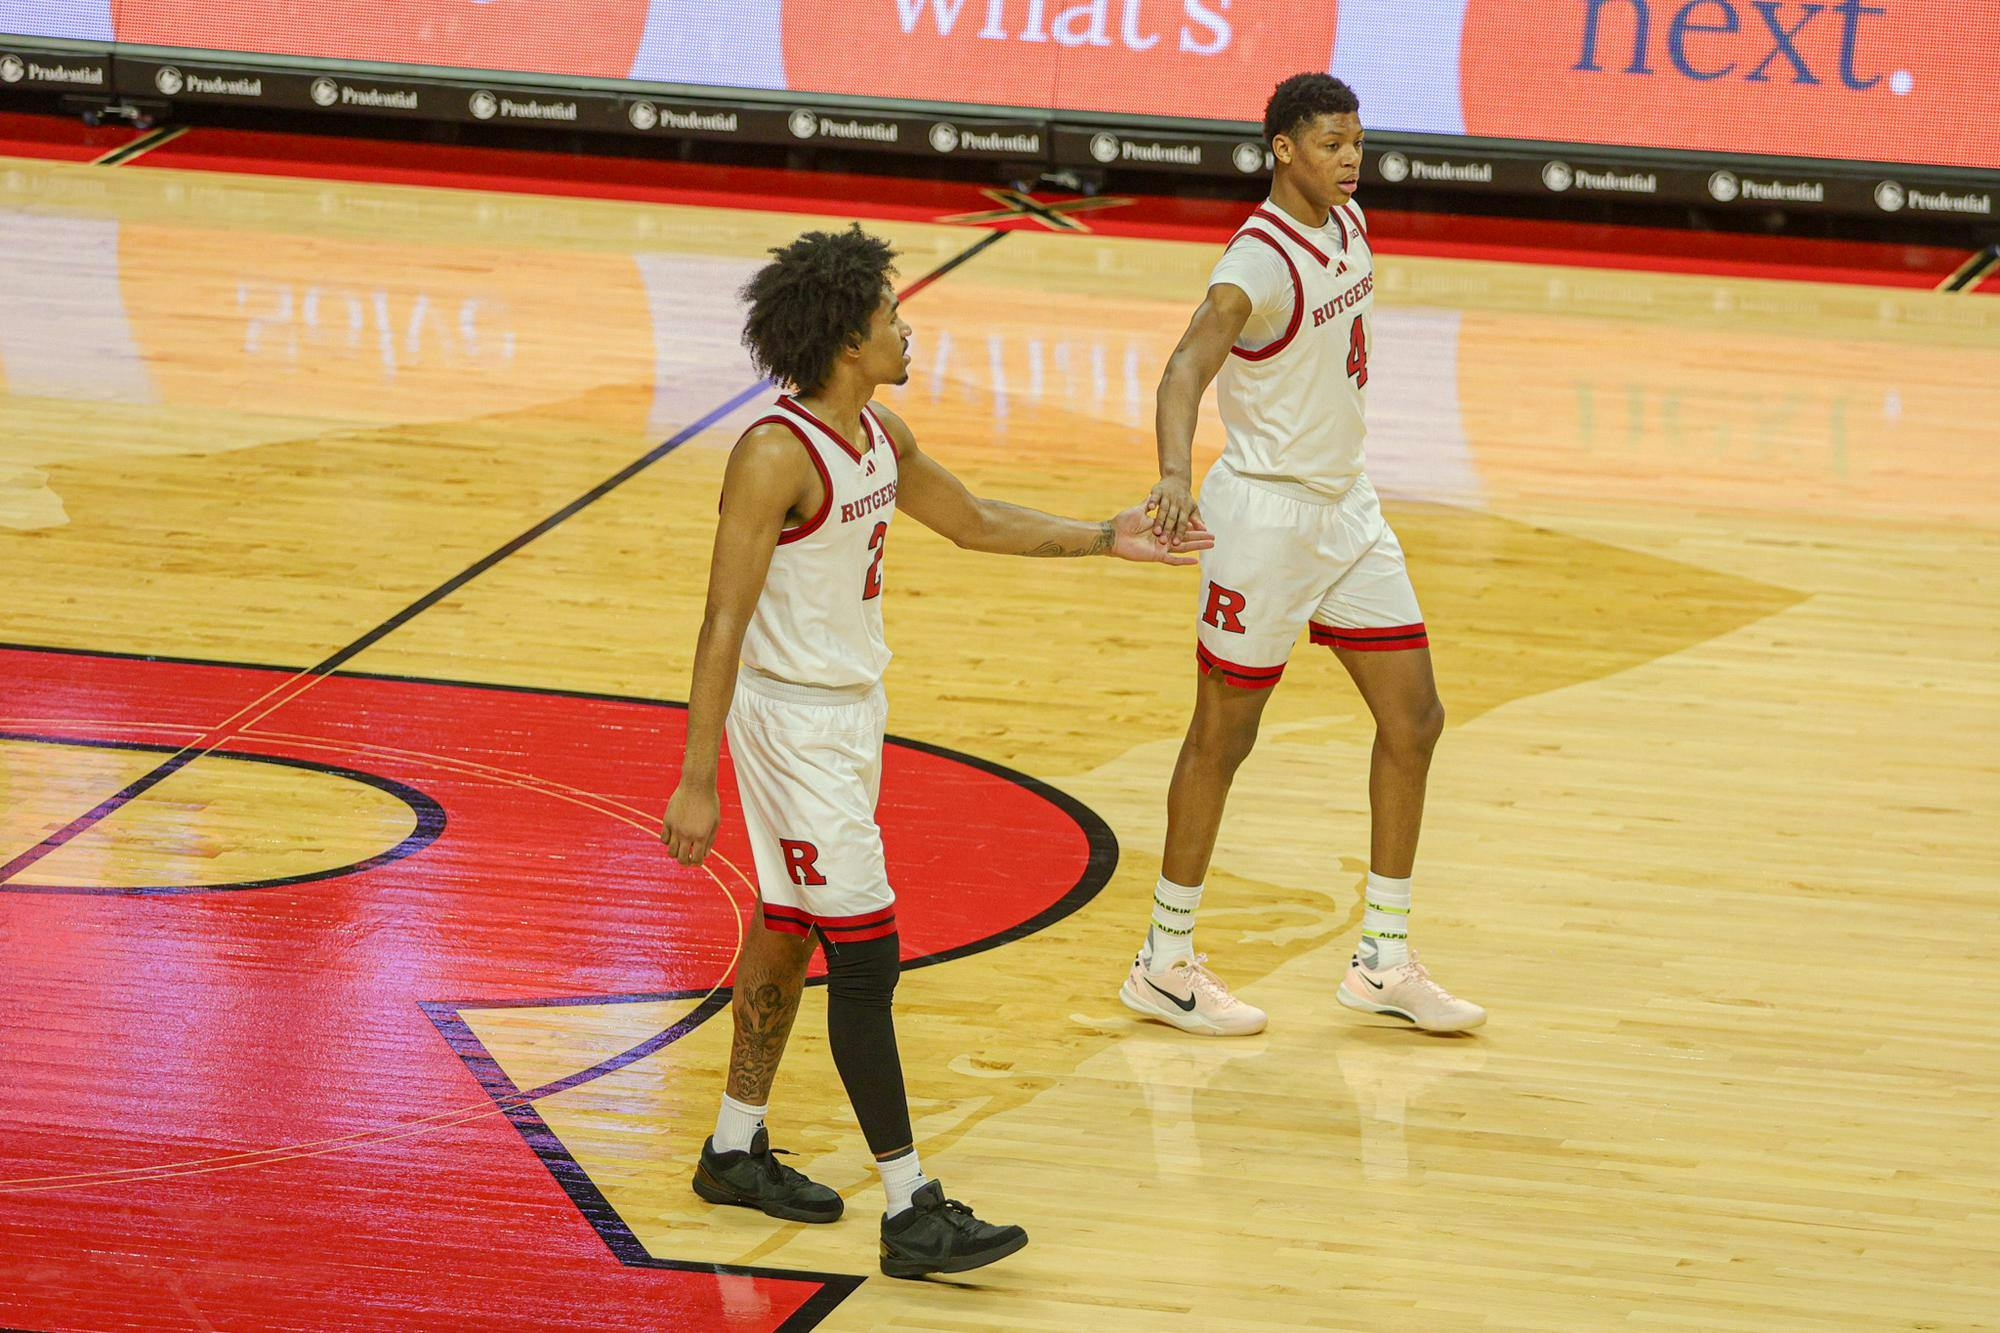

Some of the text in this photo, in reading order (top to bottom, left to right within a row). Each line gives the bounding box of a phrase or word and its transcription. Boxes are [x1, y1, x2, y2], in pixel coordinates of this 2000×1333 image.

[1570, 0, 1914, 96] next.
[28, 63, 103, 85] Prudential
[187, 75, 262, 97] Prudential
[342, 87, 418, 109] Prudential
[500, 99, 577, 121] Prudential
[661, 110, 738, 132] Prudential
[820, 118, 898, 142] Prudential
[961, 131, 1040, 153] Prudential
[1123, 141, 1201, 165] Prudential
[1412, 160, 1492, 182] Prudential
[1575, 170, 1656, 193] Prudential
[1742, 179, 1824, 202] Prudential
[1908, 190, 1991, 214] Prudential
[1312, 270, 1373, 327] RUTGERS
[1346, 313, 1368, 390] 4
[841, 480, 897, 523] RUTGERS
[862, 521, 887, 601] 2
[1202, 580, 1246, 634] R
[779, 838, 827, 885] R
